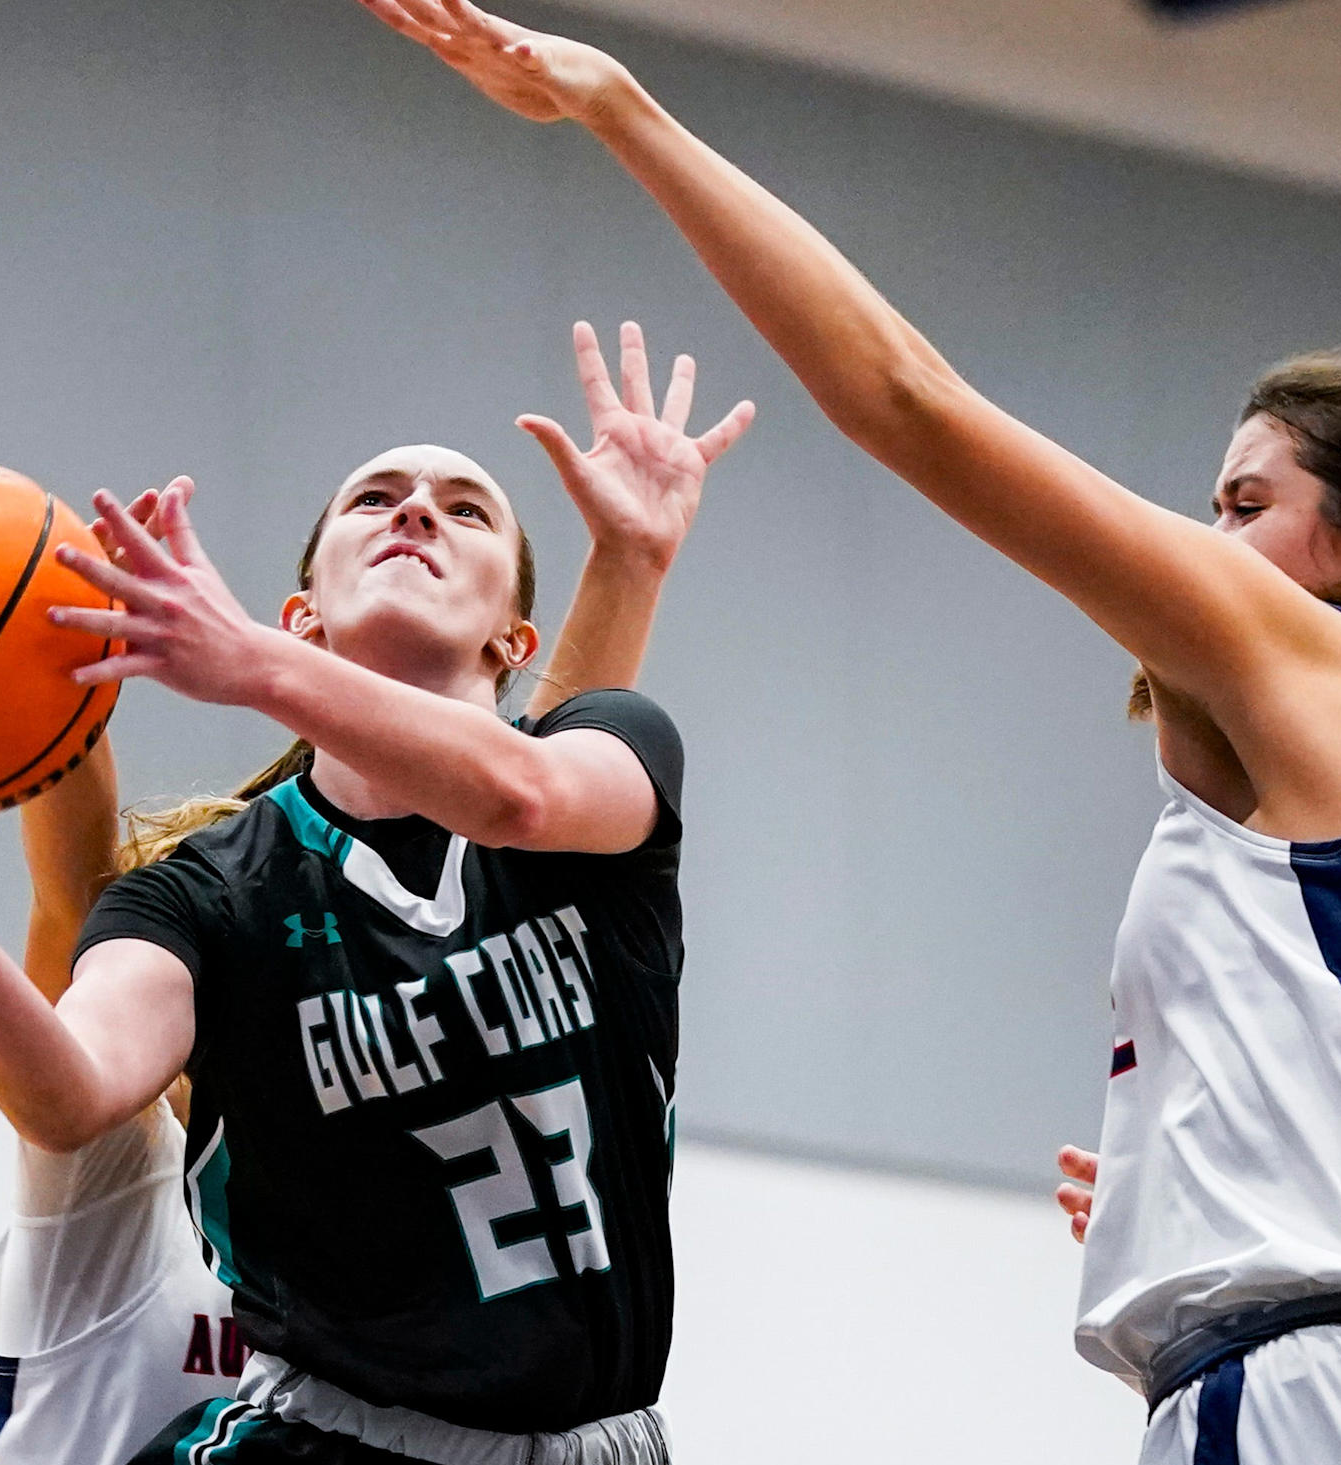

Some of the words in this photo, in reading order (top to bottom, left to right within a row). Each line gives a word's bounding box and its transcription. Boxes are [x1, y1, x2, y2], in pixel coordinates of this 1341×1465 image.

[296, 976, 446, 1115] GULF
[443, 903, 596, 1057] COAST
[407, 1074, 611, 1304] 23
